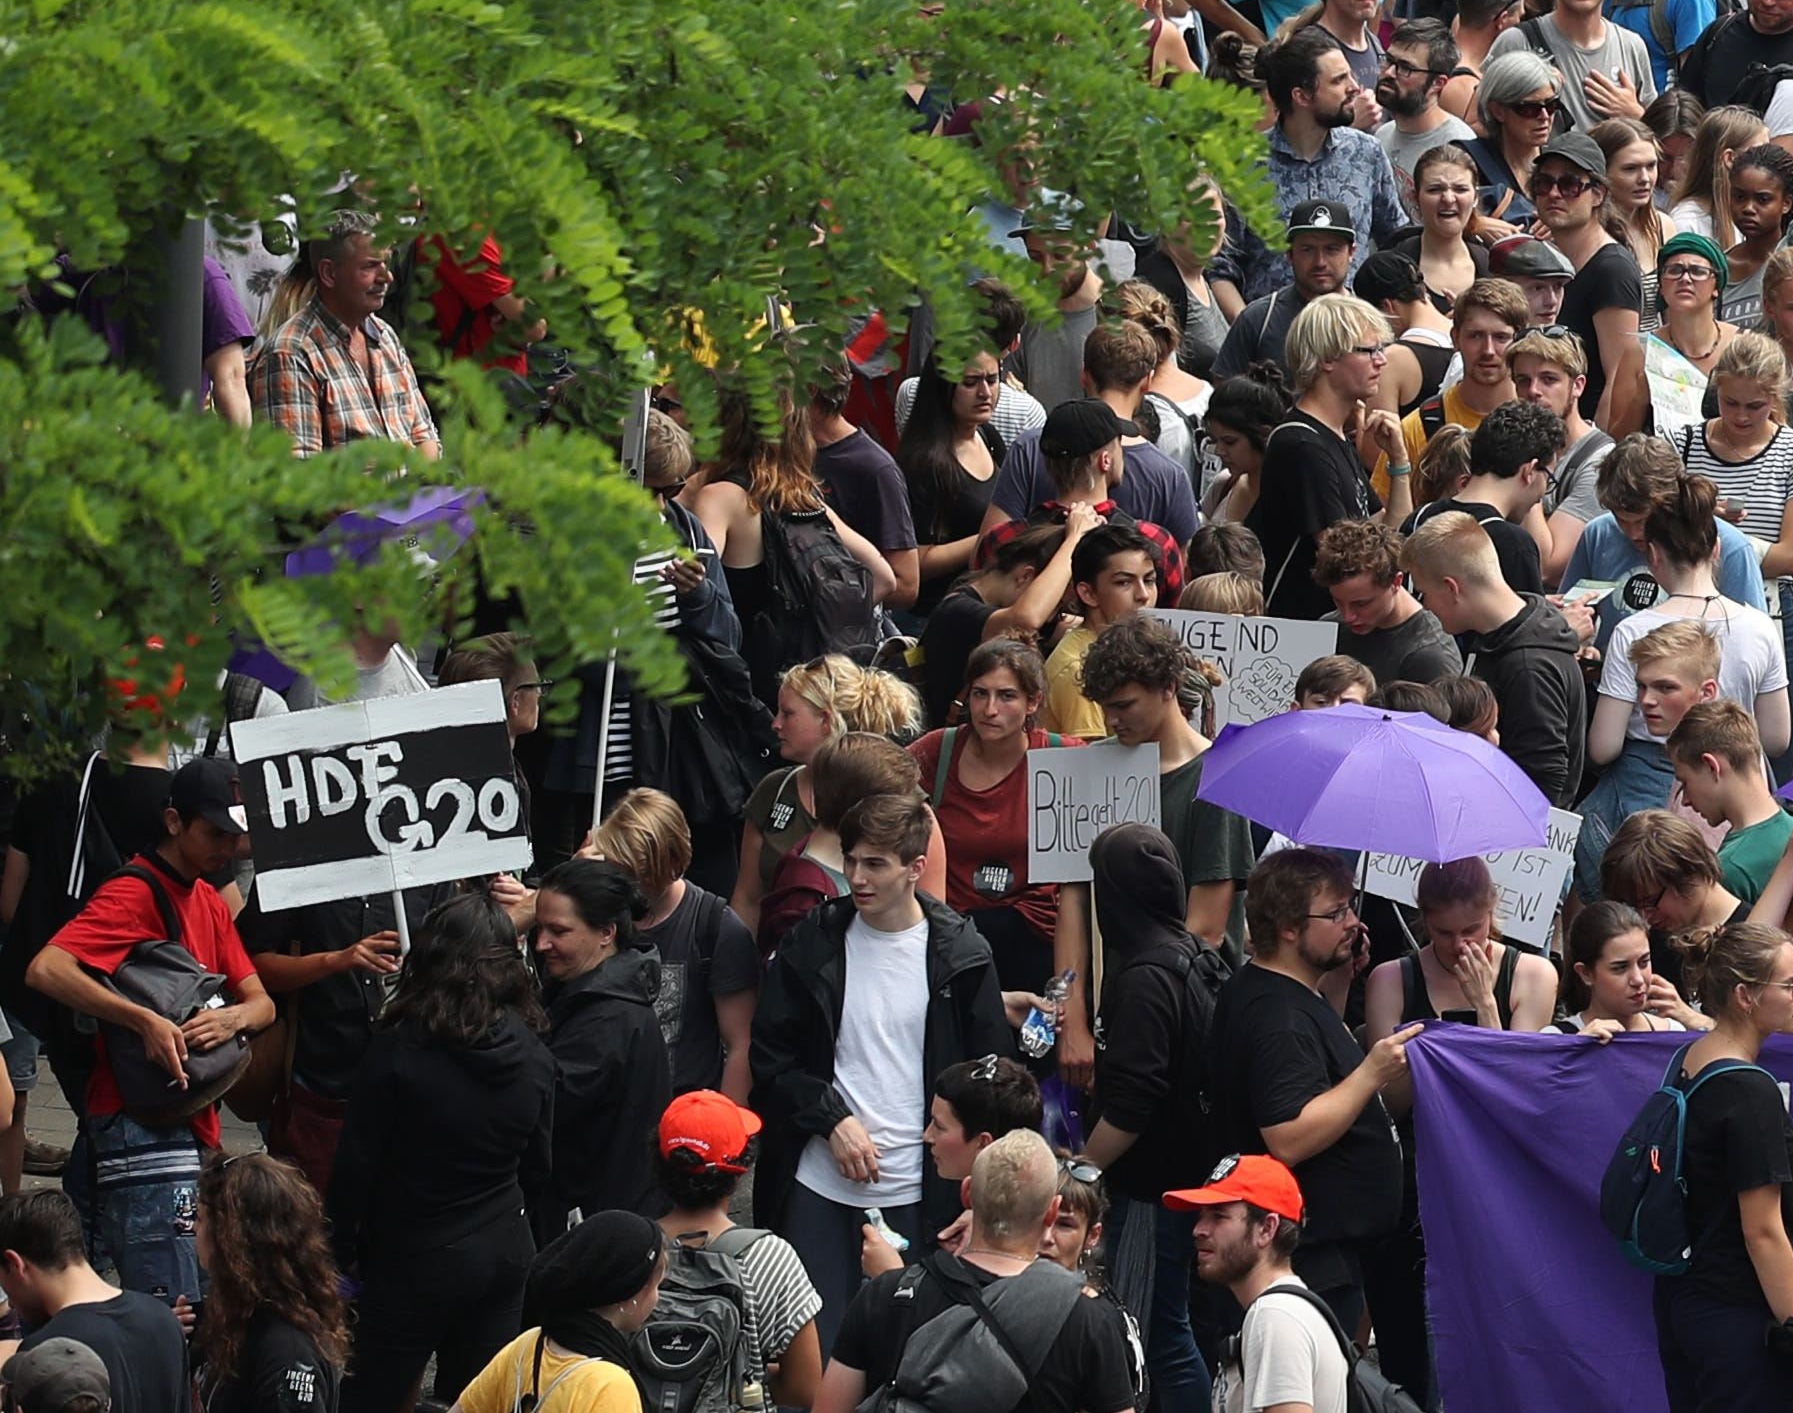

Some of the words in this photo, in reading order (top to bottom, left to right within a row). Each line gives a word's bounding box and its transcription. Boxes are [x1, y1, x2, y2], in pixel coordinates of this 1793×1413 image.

[1631, 578, 1657, 592] JUGEND
[1632, 587, 1653, 599] GEGEN
[263, 738, 406, 830] HDF
[362, 776, 521, 857] G20
[1035, 769, 1090, 854] Bitte
[286, 1370, 316, 1384] JUGEND
[289, 1380, 314, 1393] GEGEN
